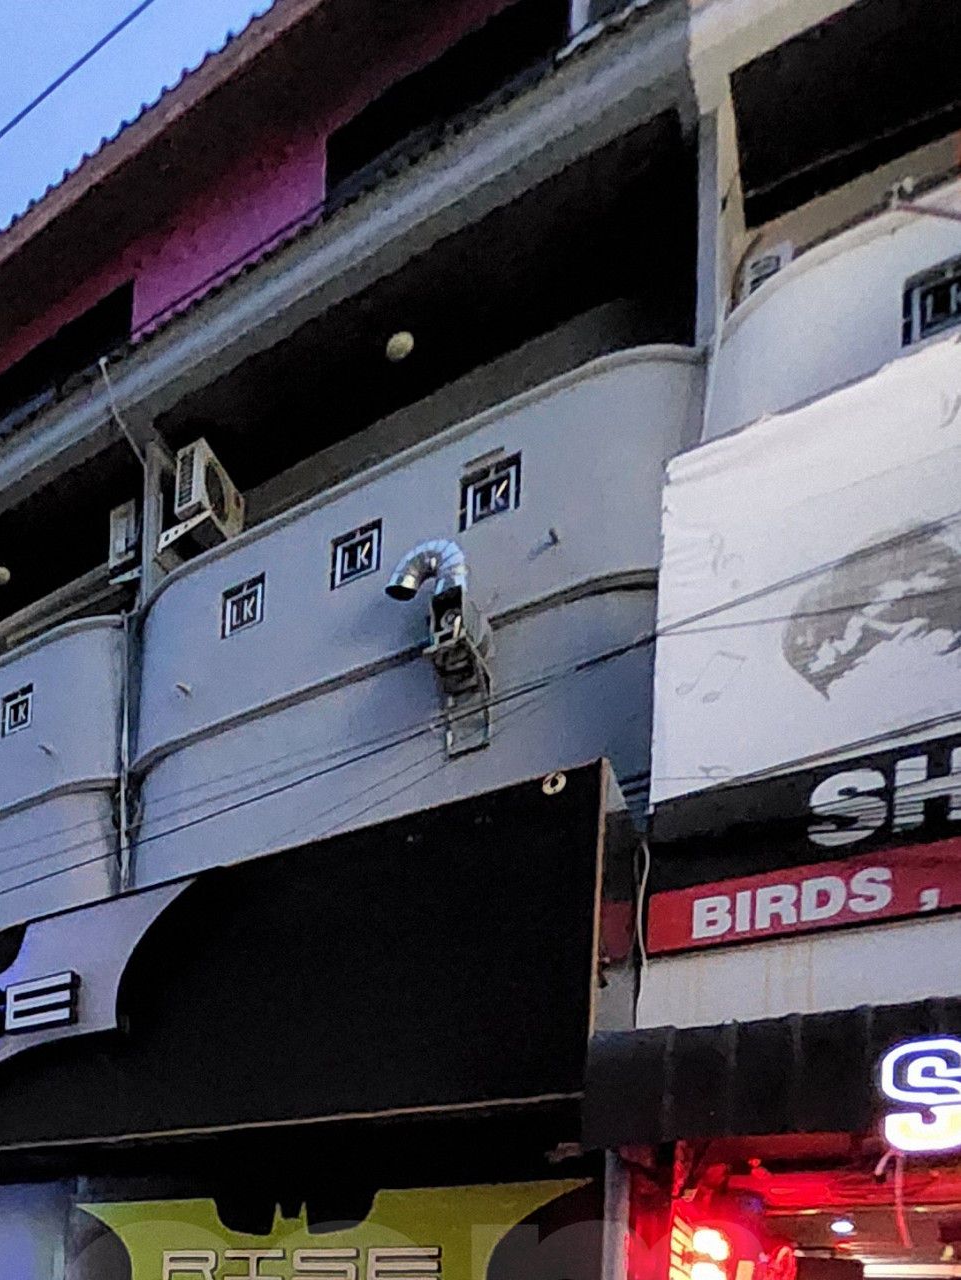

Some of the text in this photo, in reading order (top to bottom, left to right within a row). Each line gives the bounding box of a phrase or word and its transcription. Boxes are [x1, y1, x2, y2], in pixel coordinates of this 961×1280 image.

[342, 541, 371, 574] LK
[231, 598, 256, 627] LK
[691, 867, 892, 939] BIRDS
